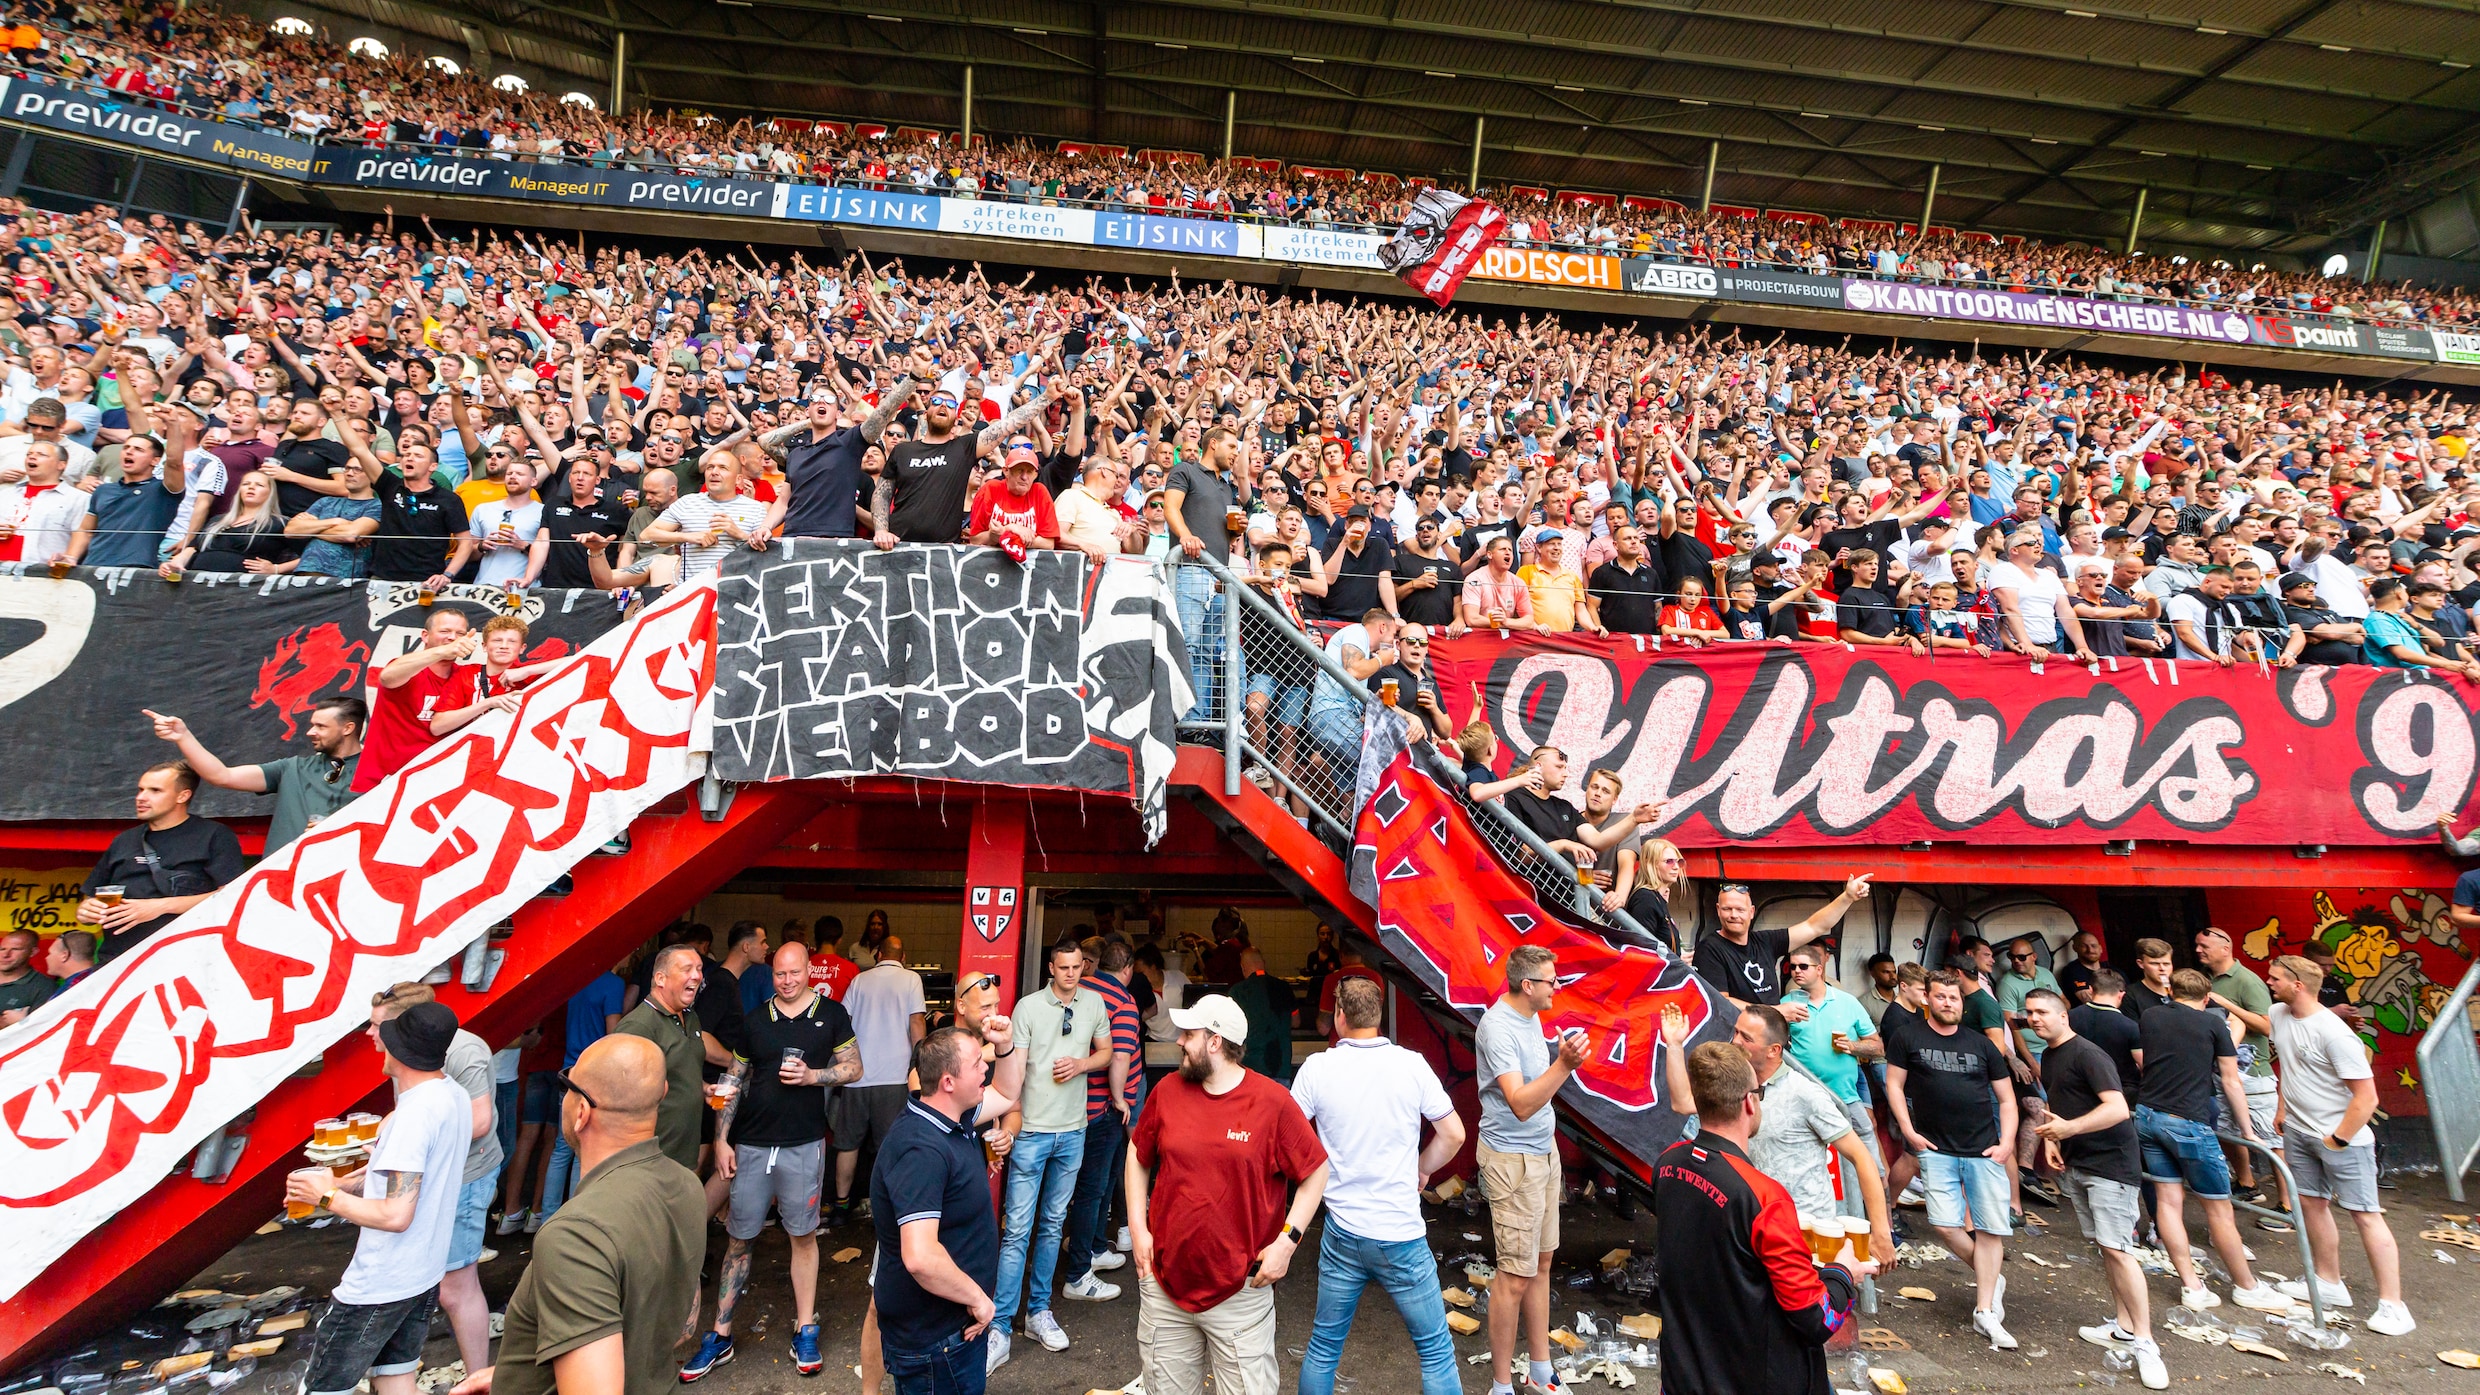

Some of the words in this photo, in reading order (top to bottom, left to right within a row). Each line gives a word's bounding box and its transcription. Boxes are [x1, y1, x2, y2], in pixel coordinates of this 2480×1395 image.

[15, 92, 201, 147] previder
[213, 138, 310, 173] Managed
[312, 159, 331, 174] IT
[356, 158, 490, 186] previder
[510, 175, 590, 197] Managed
[593, 181, 609, 196] IT
[629, 181, 764, 208] previder
[973, 205, 1055, 222] afreken
[962, 219, 1064, 237] systemen
[1290, 231, 1367, 248] afreken
[1282, 246, 1377, 262] systemen
[1641, 269, 1717, 290] ABRO
[1736, 278, 1840, 299] PROJECTAFBOUW
[2441, 334, 2468, 350] VAN
[909, 455, 947, 468] RAW.
[716, 546, 1086, 646] SEKTION
[714, 612, 1082, 720] STADION
[713, 687, 1090, 780] VERBOD
[1500, 652, 2254, 836] Ultras
[0, 878, 40, 905] HET
[36, 882, 84, 905] JAA
[1676, 1166, 1729, 1208] TWENTE
